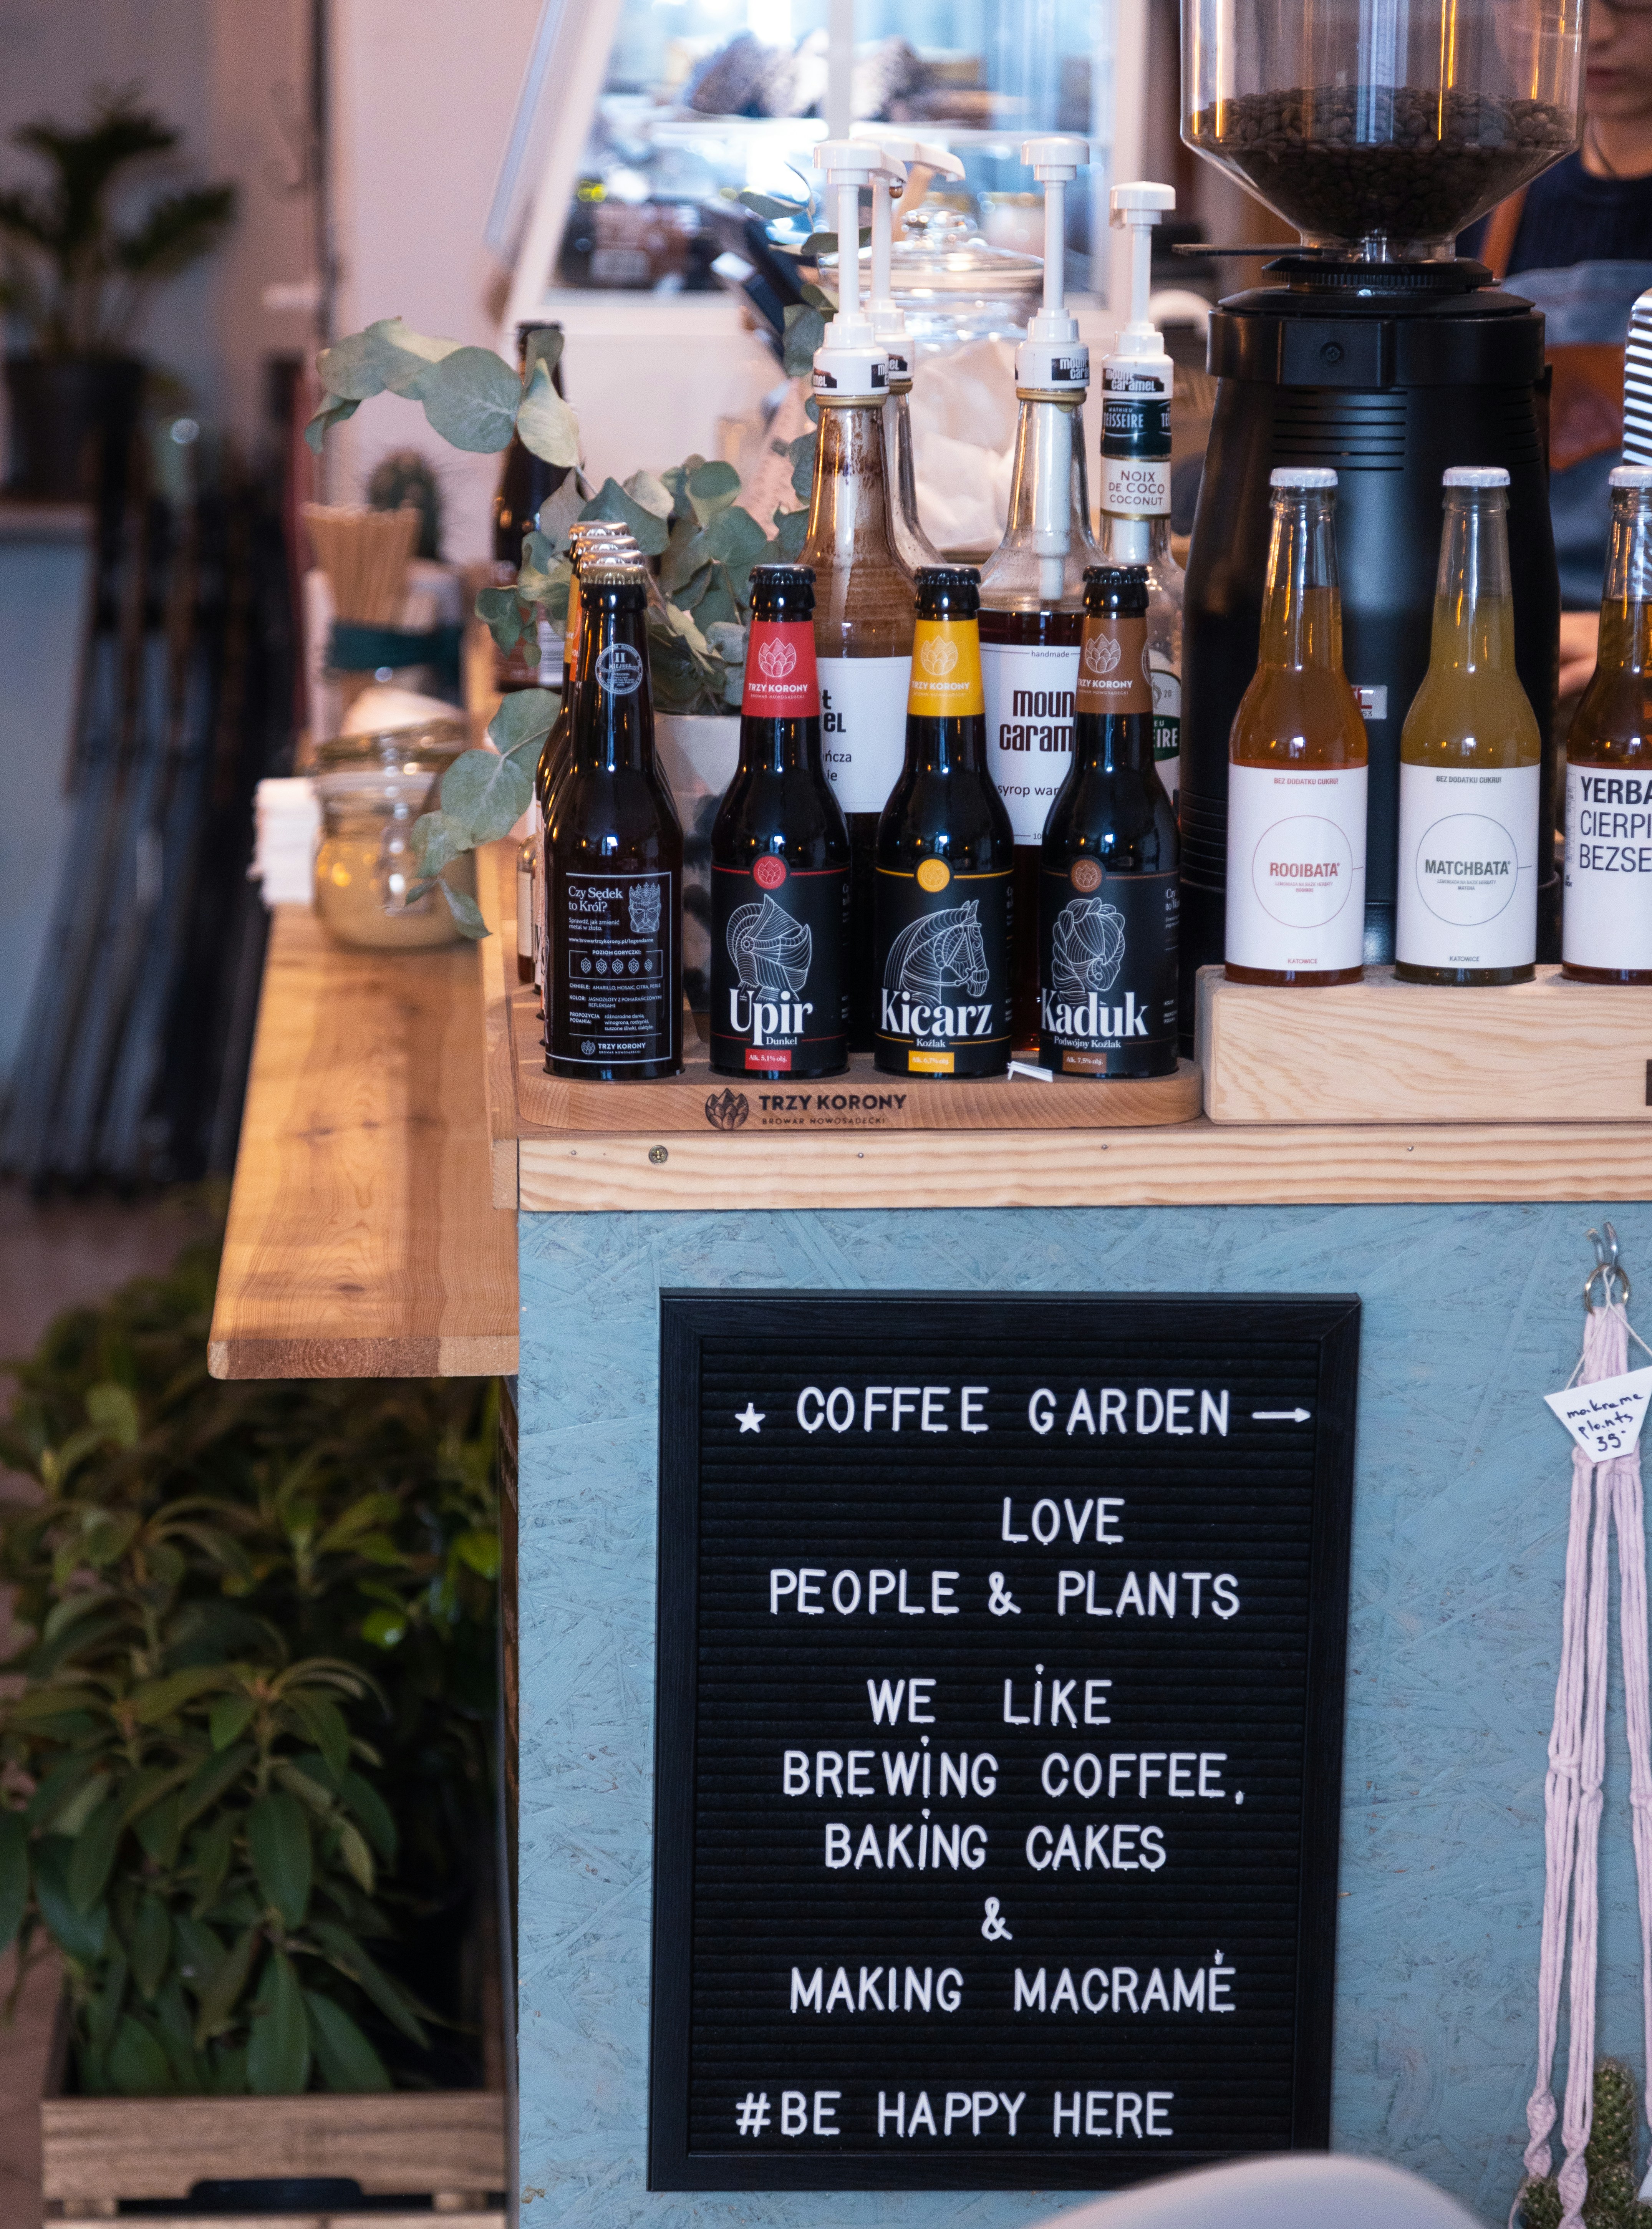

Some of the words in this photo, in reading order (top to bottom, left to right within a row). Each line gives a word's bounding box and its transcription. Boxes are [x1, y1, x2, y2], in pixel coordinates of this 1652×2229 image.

[1121, 470, 1155, 482] NOIX
[1109, 481, 1122, 492] DE
[1127, 482, 1165, 494] COCO
[1110, 494, 1163, 505] COCONUT
[749, 683, 767, 691] TRZY
[769, 684, 808, 692] KORONY
[930, 682, 970, 690] KORONY
[1092, 680, 1133, 689] KORONY
[568, 886, 586, 899] Czy
[588, 887, 623, 900] Sędek
[569, 901, 577, 910] to
[580, 901, 607, 912] Król?
[729, 988, 813, 1046] Upir
[882, 988, 992, 1036] Kicarz
[1041, 988, 1149, 1037] Kaduk
[766, 1037, 797, 1045] Dunkel
[917, 1038, 946, 1047] Koźlak
[1054, 1036, 1089, 1049] Podwójny
[1091, 1039, 1121, 1048] Koźlak
[759, 1095, 812, 1110] TRZY
[817, 1094, 907, 1110] KORONY
[797, 1387, 988, 1434] COFFEE
[1029, 1388, 1228, 1436] GARDEN
[1578, 1411, 1633, 1440] plants
[1002, 1497, 1124, 1545] LOVE
[770, 1568, 959, 1615] PEOPLE
[989, 1572, 1021, 1616] &
[1058, 1571, 1239, 1619] PLANTS
[867, 1679, 936, 1725] WE
[1026, 1825, 1166, 1871] CAKES
[982, 1897, 1012, 1941] &
[791, 1967, 963, 2013] MAKING
[736, 2091, 840, 2137] #BE
[878, 2091, 1025, 2137] HAPPY
[1054, 2091, 1173, 2138] HERE
